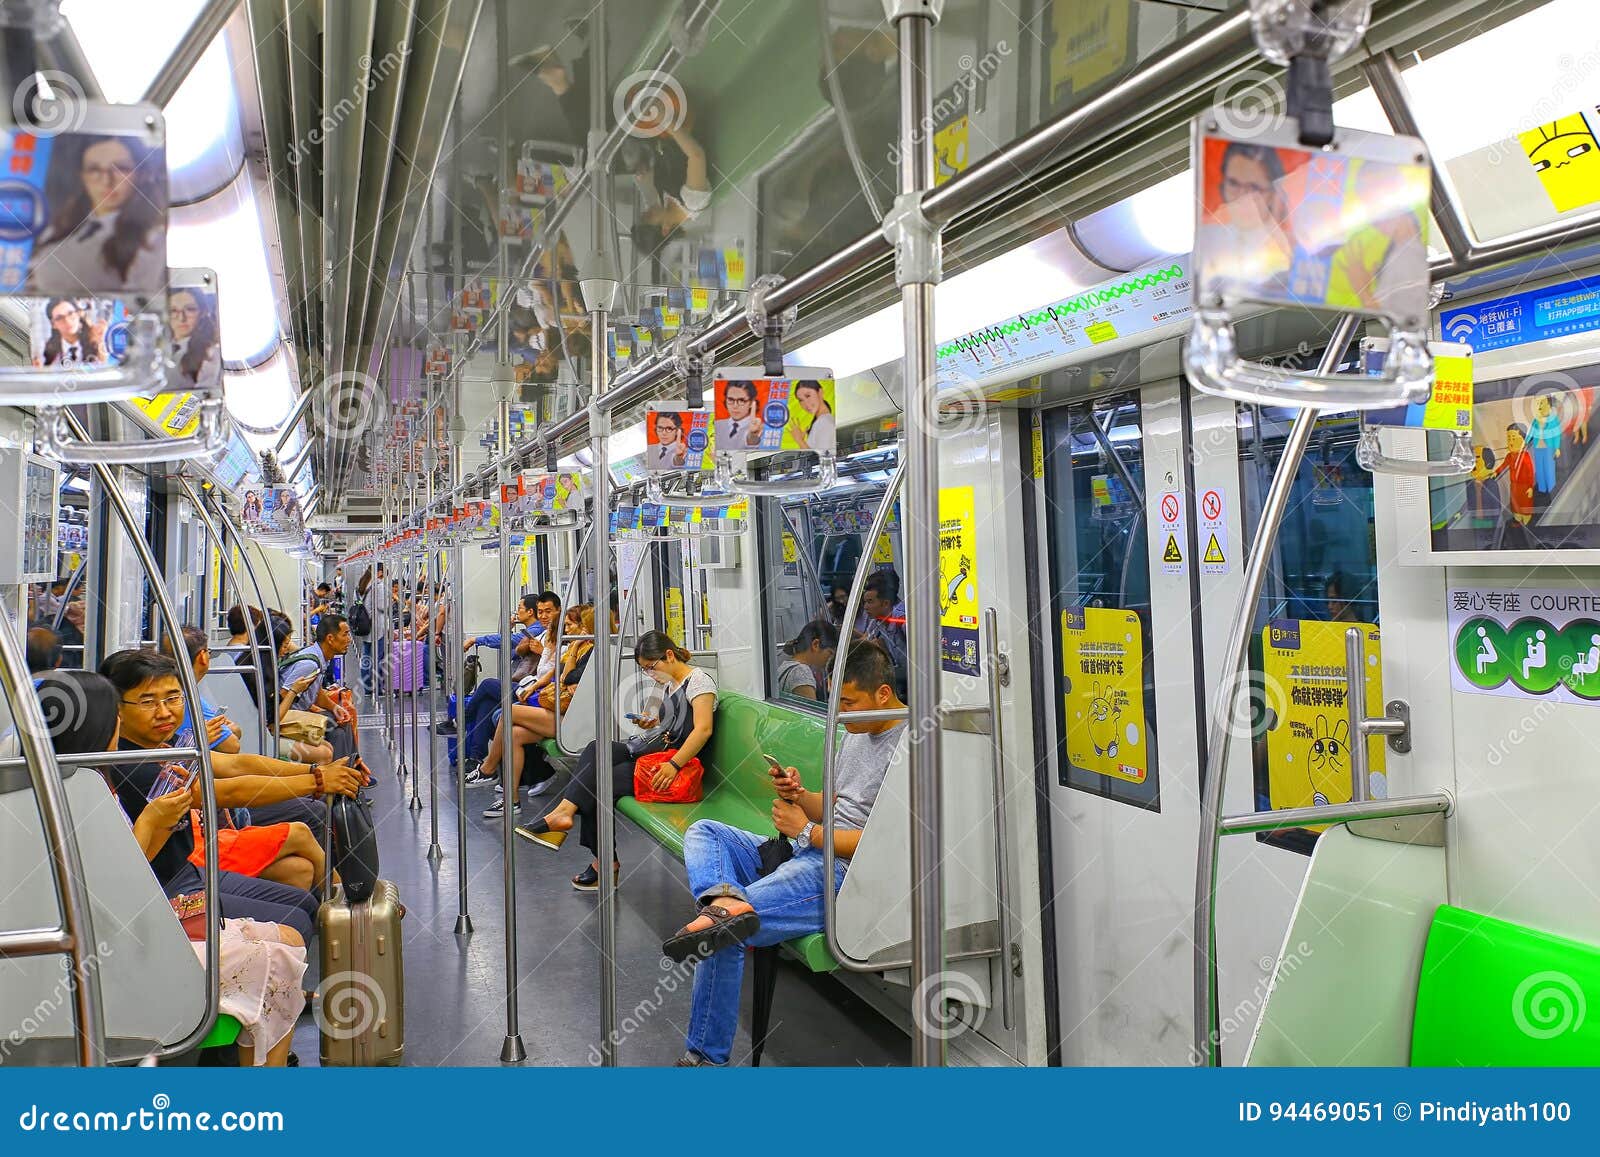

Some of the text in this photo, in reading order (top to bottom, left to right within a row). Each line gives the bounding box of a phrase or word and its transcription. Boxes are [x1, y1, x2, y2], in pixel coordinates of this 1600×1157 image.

[1479, 305, 1522, 325] 地铁Wi-Fi
[1487, 319, 1516, 335] 已覆盖
[1434, 380, 1470, 392] 发布技能
[939, 535, 962, 552] 付弹个车
[1453, 591, 1600, 612] 爱心专座 COURTE
[1291, 686, 1348, 708] 你就弹弹弹
